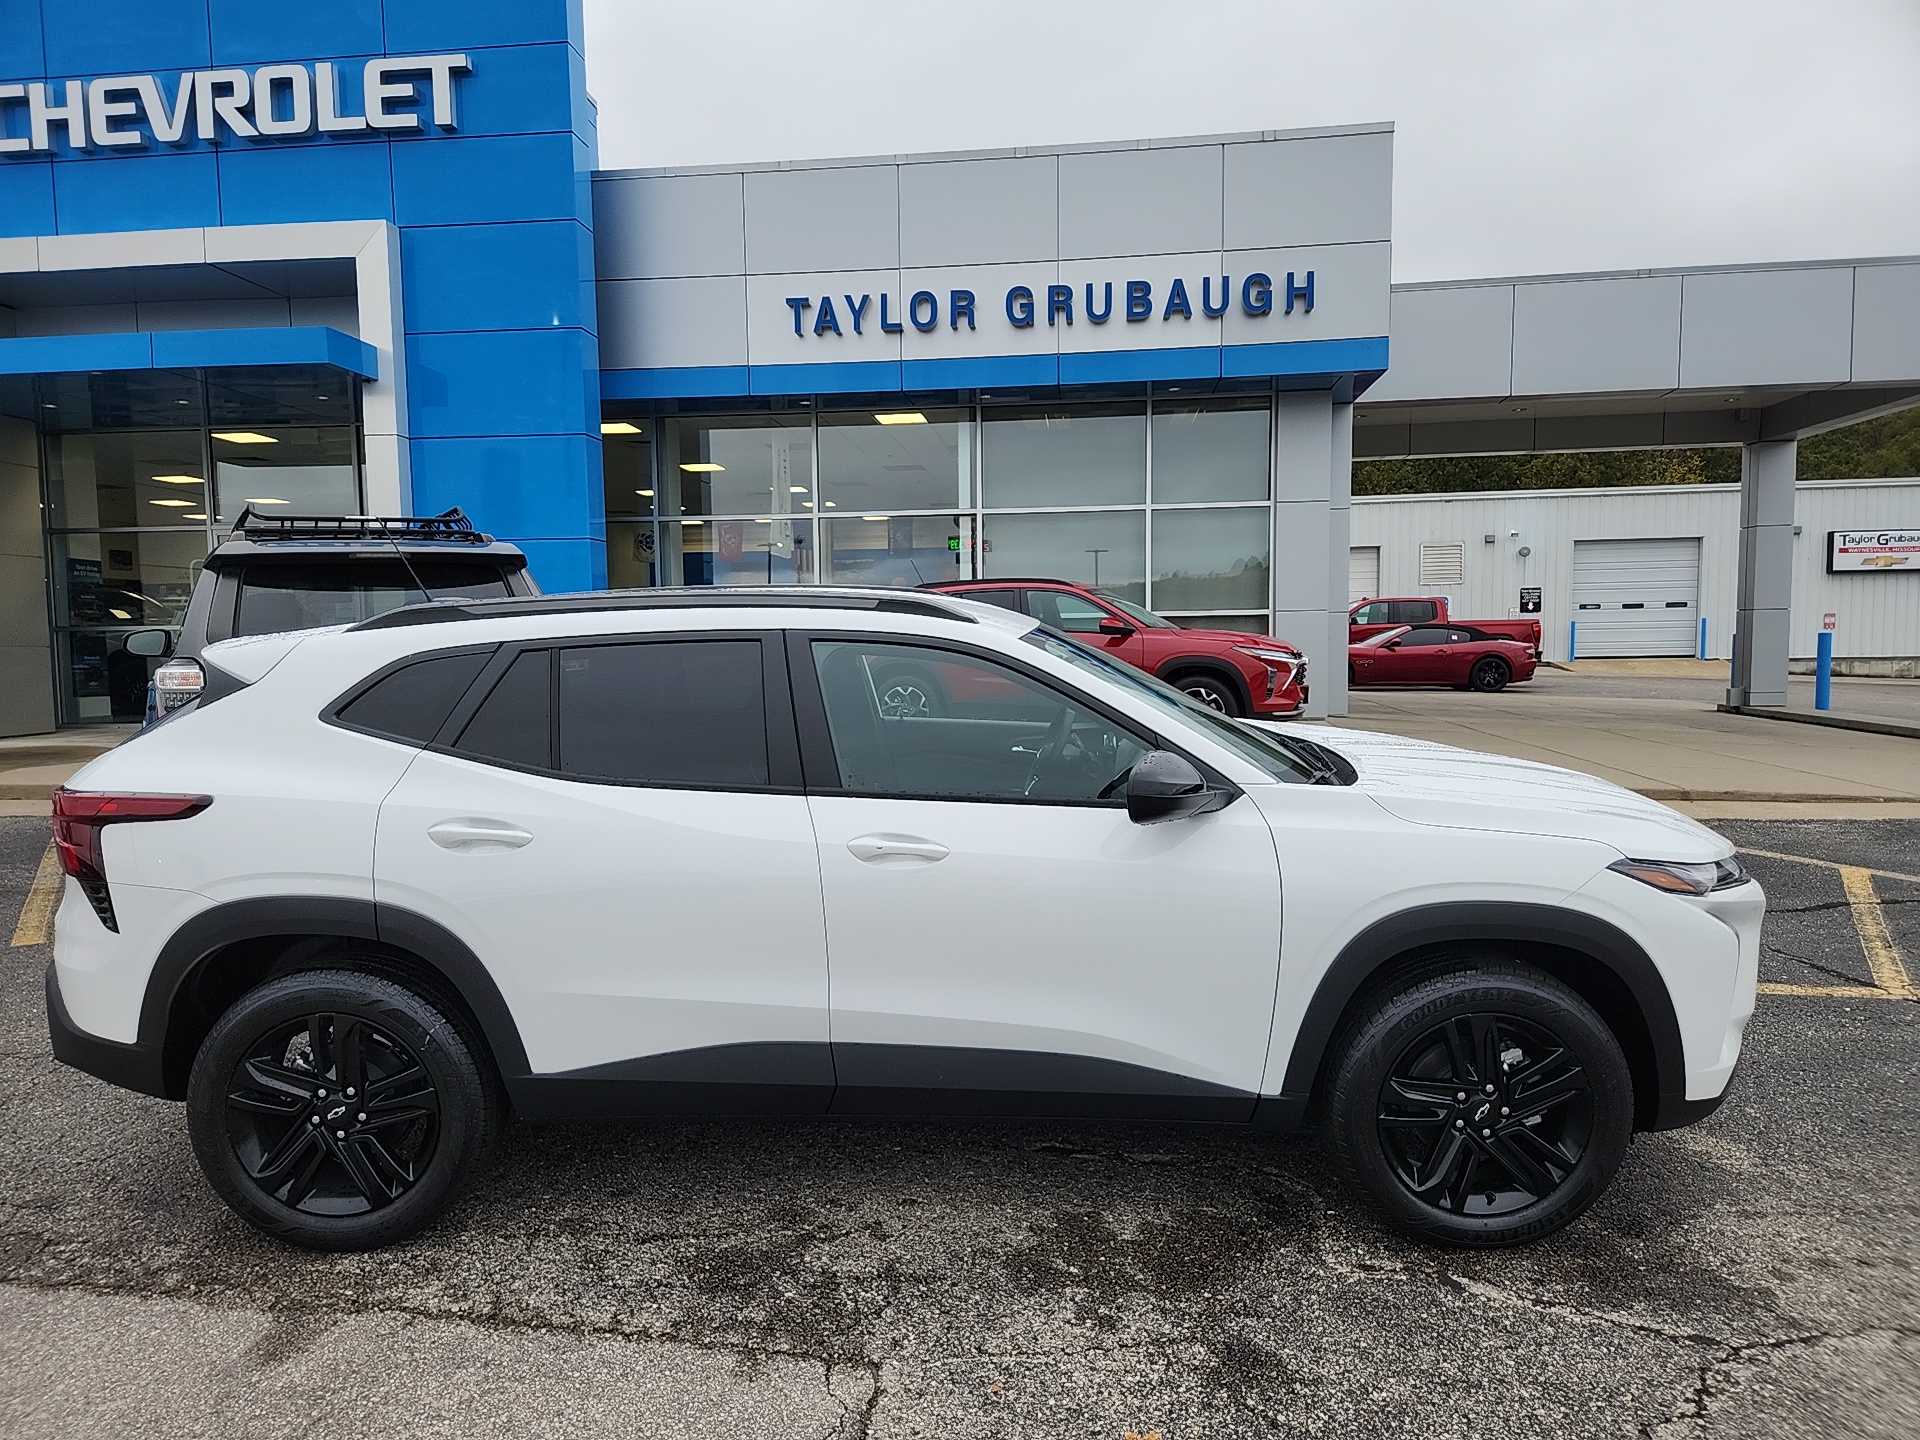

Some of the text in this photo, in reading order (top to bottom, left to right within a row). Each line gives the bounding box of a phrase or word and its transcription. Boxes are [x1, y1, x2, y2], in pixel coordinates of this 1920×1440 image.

[785, 270, 1315, 337] TAYLOR GRUBAUGH
[1839, 534, 1920, 546] Taylor Grubau
[1402, 988, 1514, 1030] GOODYEAR
